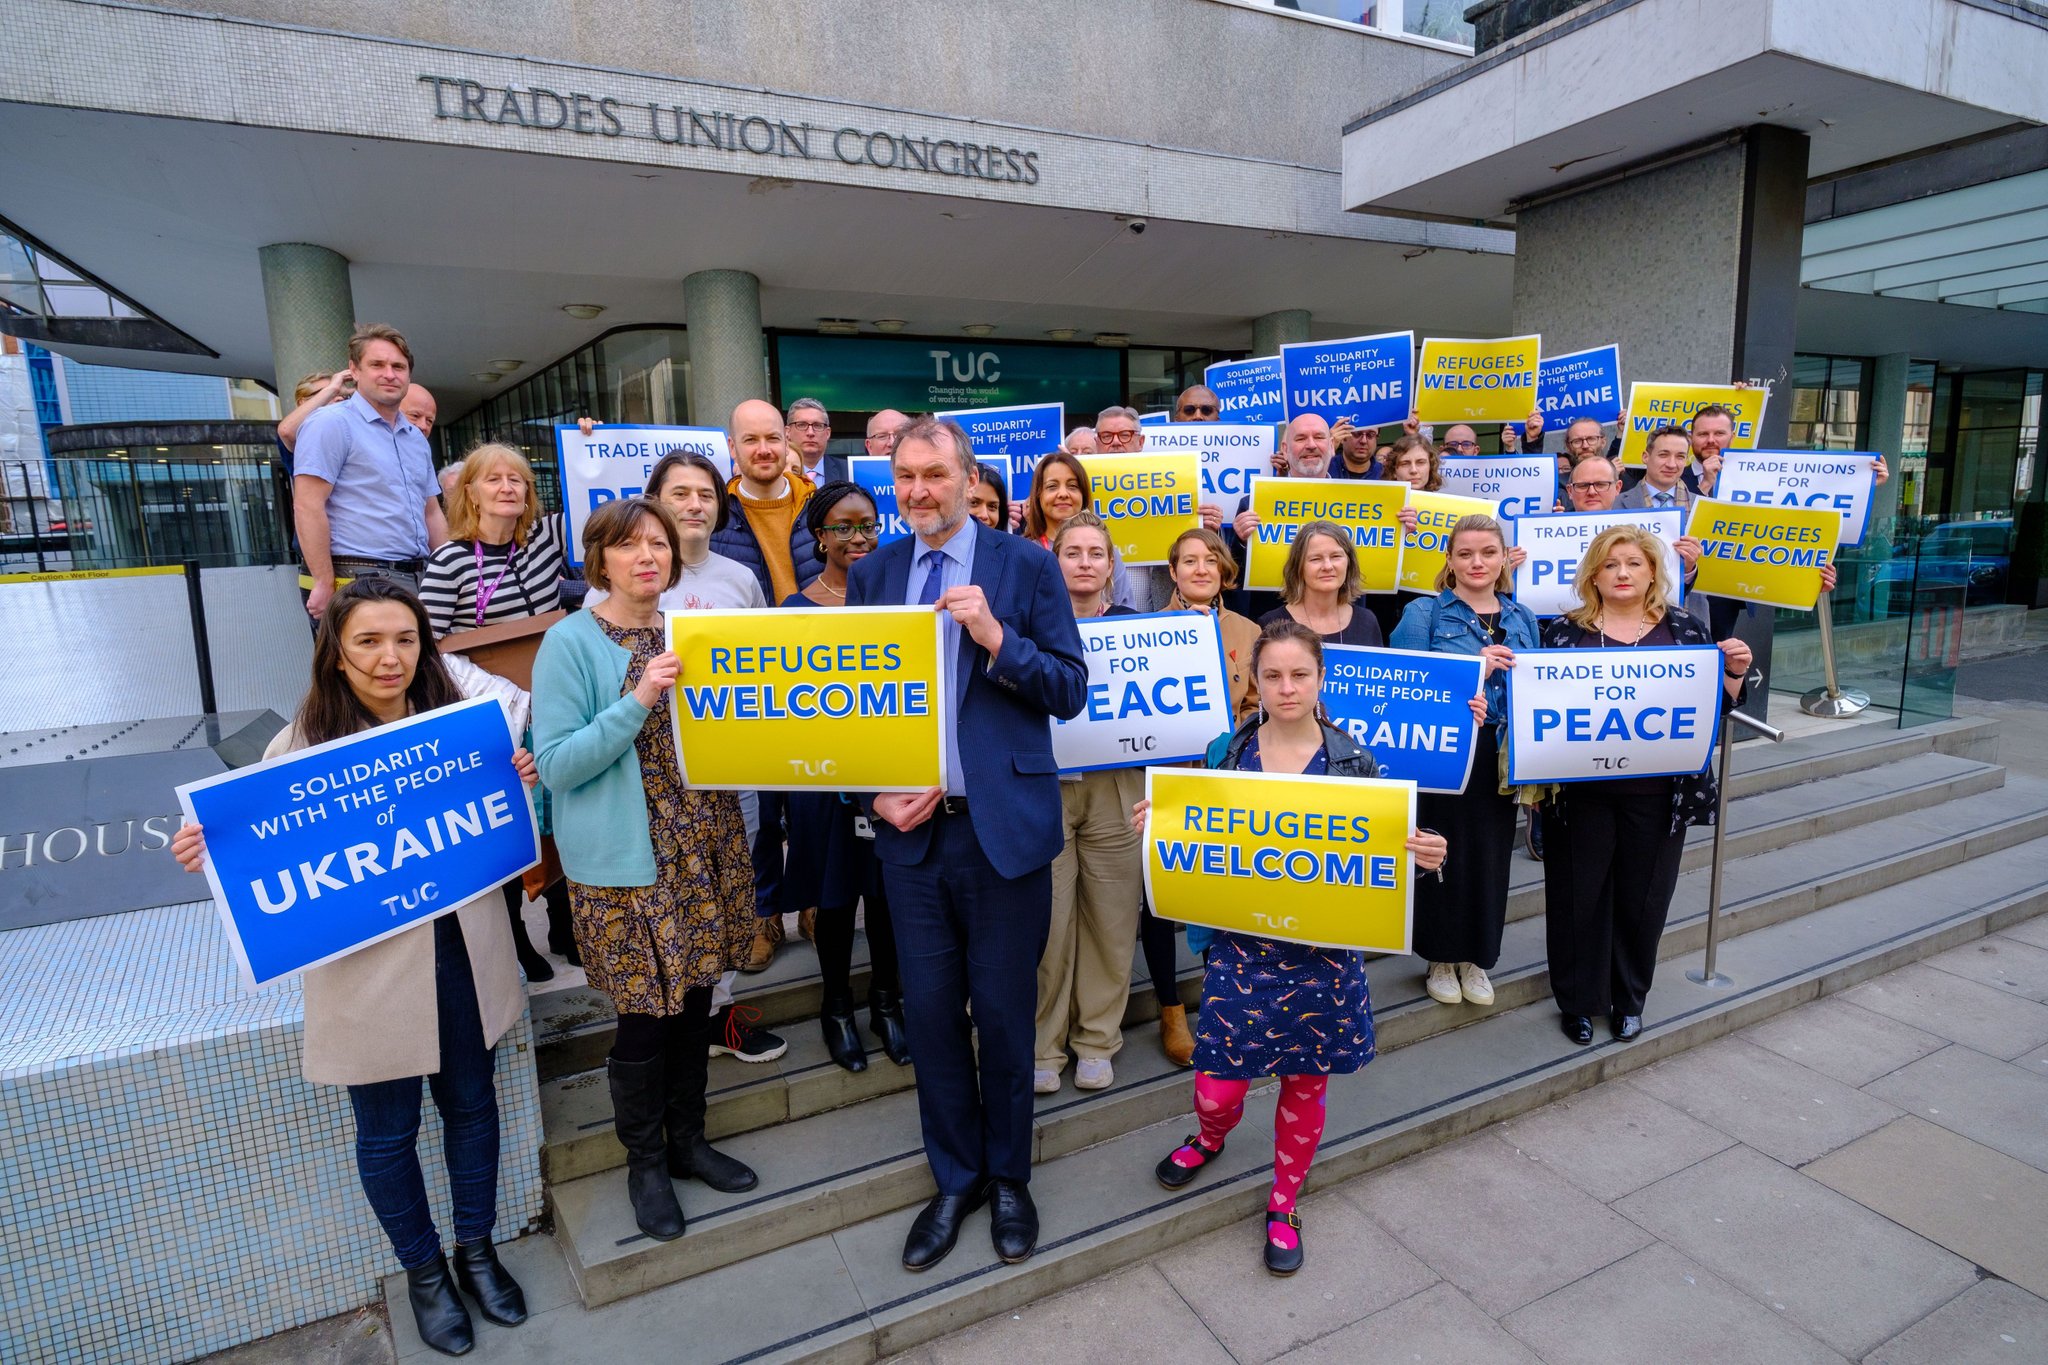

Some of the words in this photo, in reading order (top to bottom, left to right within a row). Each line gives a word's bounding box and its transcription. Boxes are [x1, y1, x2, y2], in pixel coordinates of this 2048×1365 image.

[419, 74, 622, 137] TRADES
[648, 102, 810, 159] UNION
[833, 127, 1039, 185] CONGRESS
[1315, 348, 1379, 364] SOLIDARITY
[1437, 354, 1524, 369] REFUGEES
[929, 350, 1000, 383] TUC
[1227, 366, 1272, 379] SOLIDARITY
[1299, 366, 1326, 376] WITH
[1330, 364, 1351, 374] THE
[1354, 358, 1395, 371] PEOPLE
[1538, 361, 1589, 377] OLIDARITY
[1216, 380, 1236, 389] WITH
[1238, 377, 1253, 385] THE
[1343, 374, 1353, 384] of
[1423, 371, 1534, 390] WELCOME
[1547, 375, 1566, 385] THE
[1569, 367, 1604, 381] PEOPLE
[928, 385, 965, 396] Changing
[978, 387, 1000, 395] world
[1294, 380, 1403, 408] UKRAINE
[1558, 384, 1568, 392] of
[929, 395, 937, 403] of
[969, 397, 988, 405] good
[1535, 385, 1613, 412] KRAINE
[972, 419, 1032, 433] SOLIDARITY
[1246, 414, 1263, 422] TUC
[987, 433, 1006, 444] THE
[1009, 430, 1046, 442] PEOPLE
[1150, 435, 1198, 447] TRADE
[1203, 435, 1260, 447] UNIONS
[585, 443, 650, 458] TRADE
[999, 444, 1008, 455] of
[1201, 451, 1220, 463] OR
[1439, 467, 1480, 479] TRADE
[1485, 467, 1541, 479] UNIONS
[1738, 461, 1788, 473] TRADE
[1793, 463, 1857, 475] UNIONS
[1091, 471, 1176, 493] FUGEES
[1201, 467, 1261, 495] ACE
[1472, 482, 1500, 493] FOR
[1778, 477, 1810, 488] FOR
[1093, 493, 1193, 520] LCOME
[1274, 500, 1383, 520] REFUGEES
[1534, 525, 1588, 539] TRADE
[1711, 520, 1822, 543] REFUGEES
[1115, 543, 1138, 556] UC
[31, 573, 64, 582] Caution
[71, 572, 86, 580] Wet
[1736, 582, 1766, 595] TUC
[1123, 629, 1199, 650] UNIONS
[710, 643, 902, 674] REFUGEES
[1109, 656, 1150, 674] FOR
[1333, 663, 1430, 684] SOLIDARITY
[1533, 664, 1603, 680] TRADE
[1611, 663, 1696, 680] UNIONS
[682, 680, 929, 721] WELCOME
[1056, 674, 1211, 725] EACE
[1322, 681, 1349, 695] ITH
[1355, 683, 1386, 698] THE
[1391, 686, 1452, 704] PEOPLE
[1594, 686, 1636, 701] FOR
[1373, 702, 1388, 716] of
[1533, 706, 1697, 742] PEACE
[1119, 735, 1157, 753] TUC
[289, 738, 441, 802] SOLIDARITY
[787, 759, 838, 777] TUC
[1592, 756, 1631, 770] TUC
[250, 802, 328, 840] WITH
[334, 783, 388, 813] THE
[394, 751, 483, 795] PEOPLE
[376, 804, 397, 826] of
[1184, 805, 1370, 843] REFUGEES
[250, 789, 514, 915] UKRAINE
[1155, 839, 1397, 890] WELCOME
[379, 881, 440, 917] TUC
[1251, 912, 1299, 931] TUC
